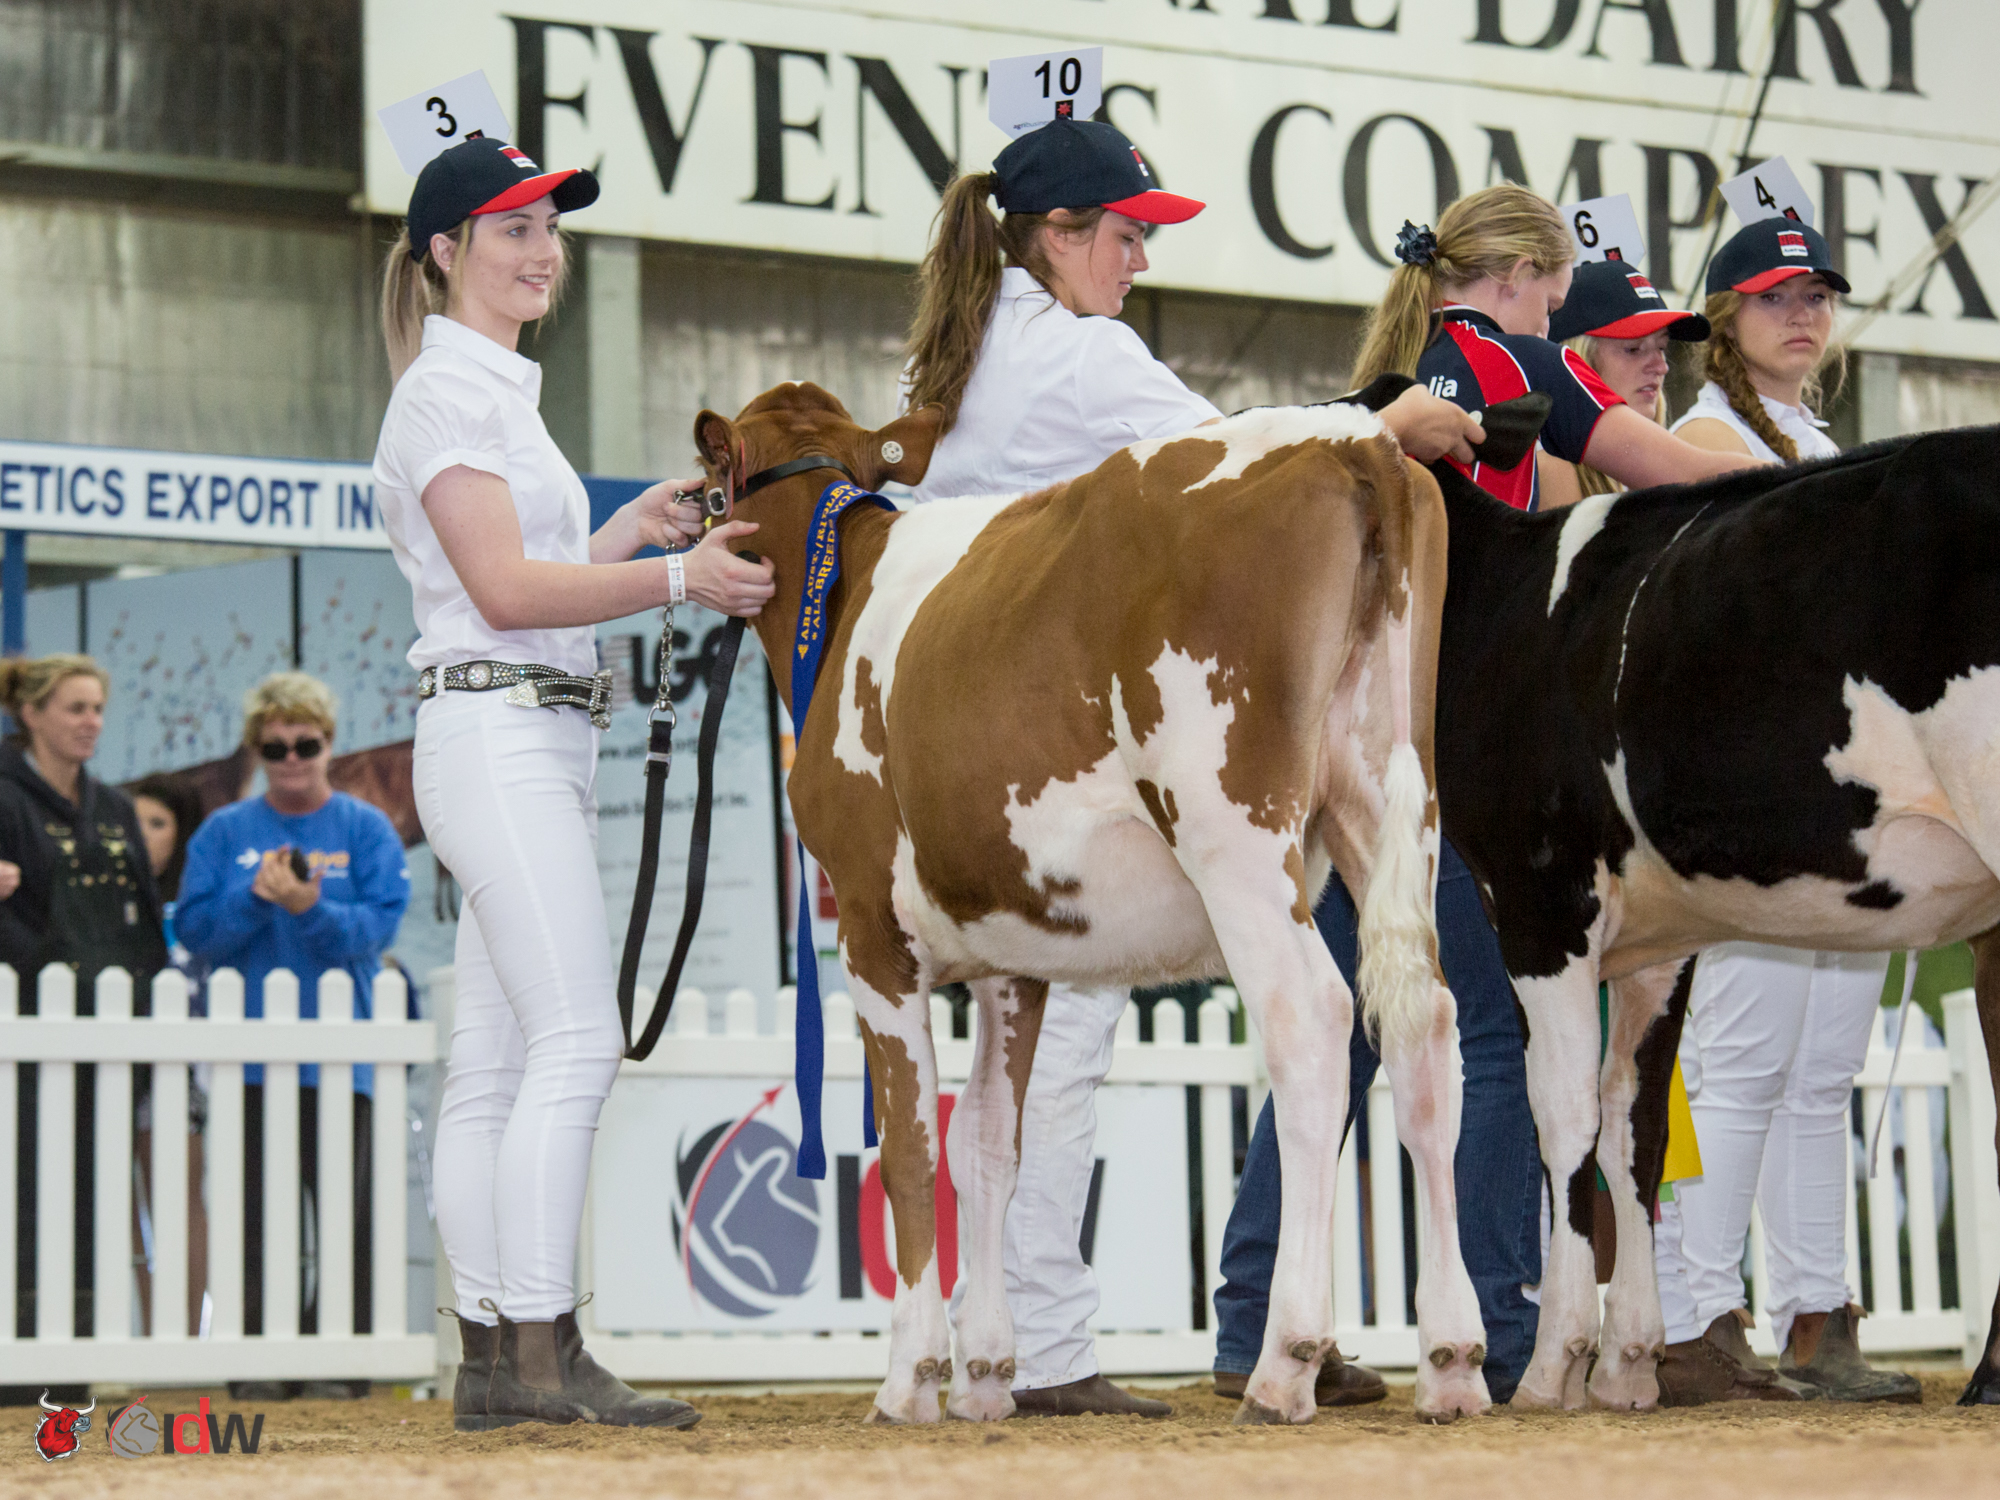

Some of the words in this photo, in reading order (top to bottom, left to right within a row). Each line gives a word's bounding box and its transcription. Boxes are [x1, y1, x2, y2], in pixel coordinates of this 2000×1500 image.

[1034, 57, 1082, 98] 10
[426, 96, 457, 138] 3
[1754, 176, 1776, 209] 4
[1574, 210, 1599, 248] 6
[146, 472, 319, 527] EXPORT
[337, 483, 385, 531] IN
[813, 593, 822, 628] ALL
